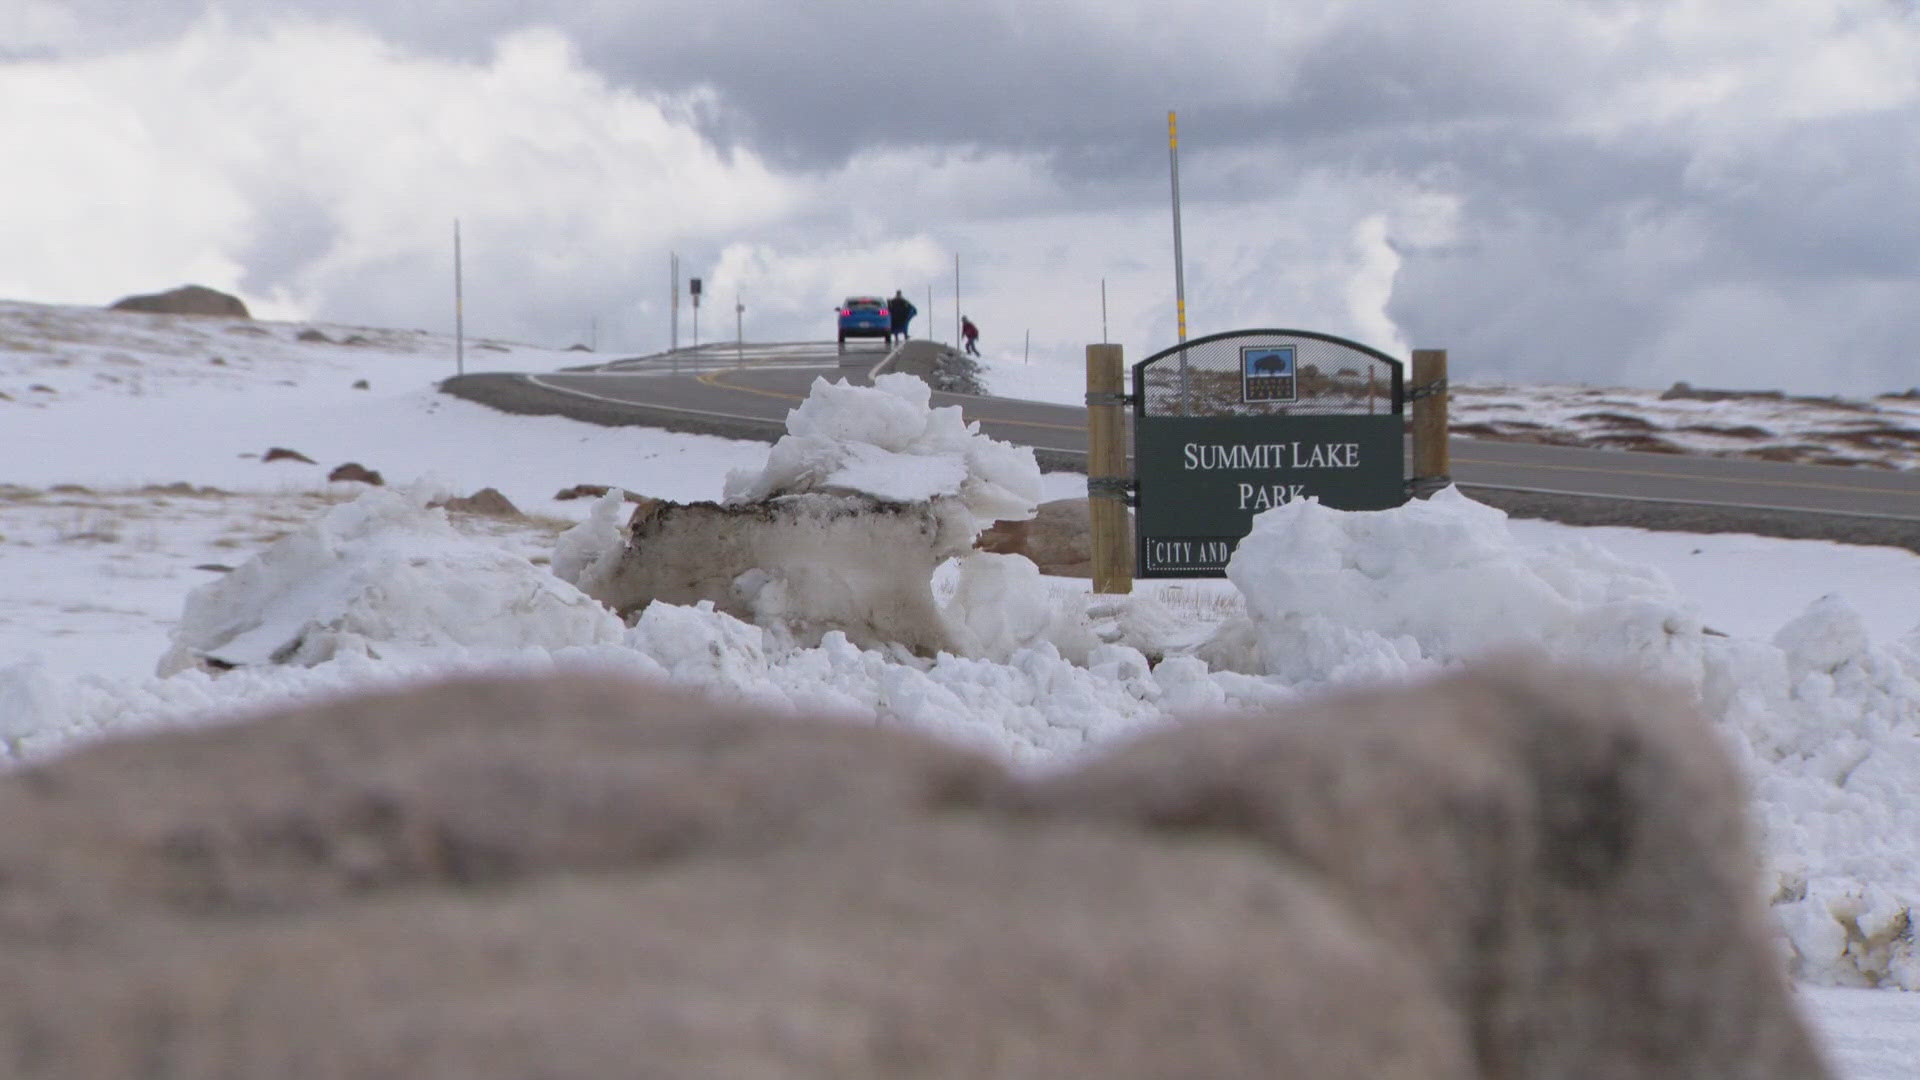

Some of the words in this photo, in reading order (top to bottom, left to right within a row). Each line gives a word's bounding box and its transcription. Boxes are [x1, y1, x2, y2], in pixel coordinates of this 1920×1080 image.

[1184, 442, 1286, 470] SUMMIT
[1291, 441, 1360, 468] LAKE
[1156, 542, 1192, 563] CITY
[1199, 542, 1228, 563] AND
